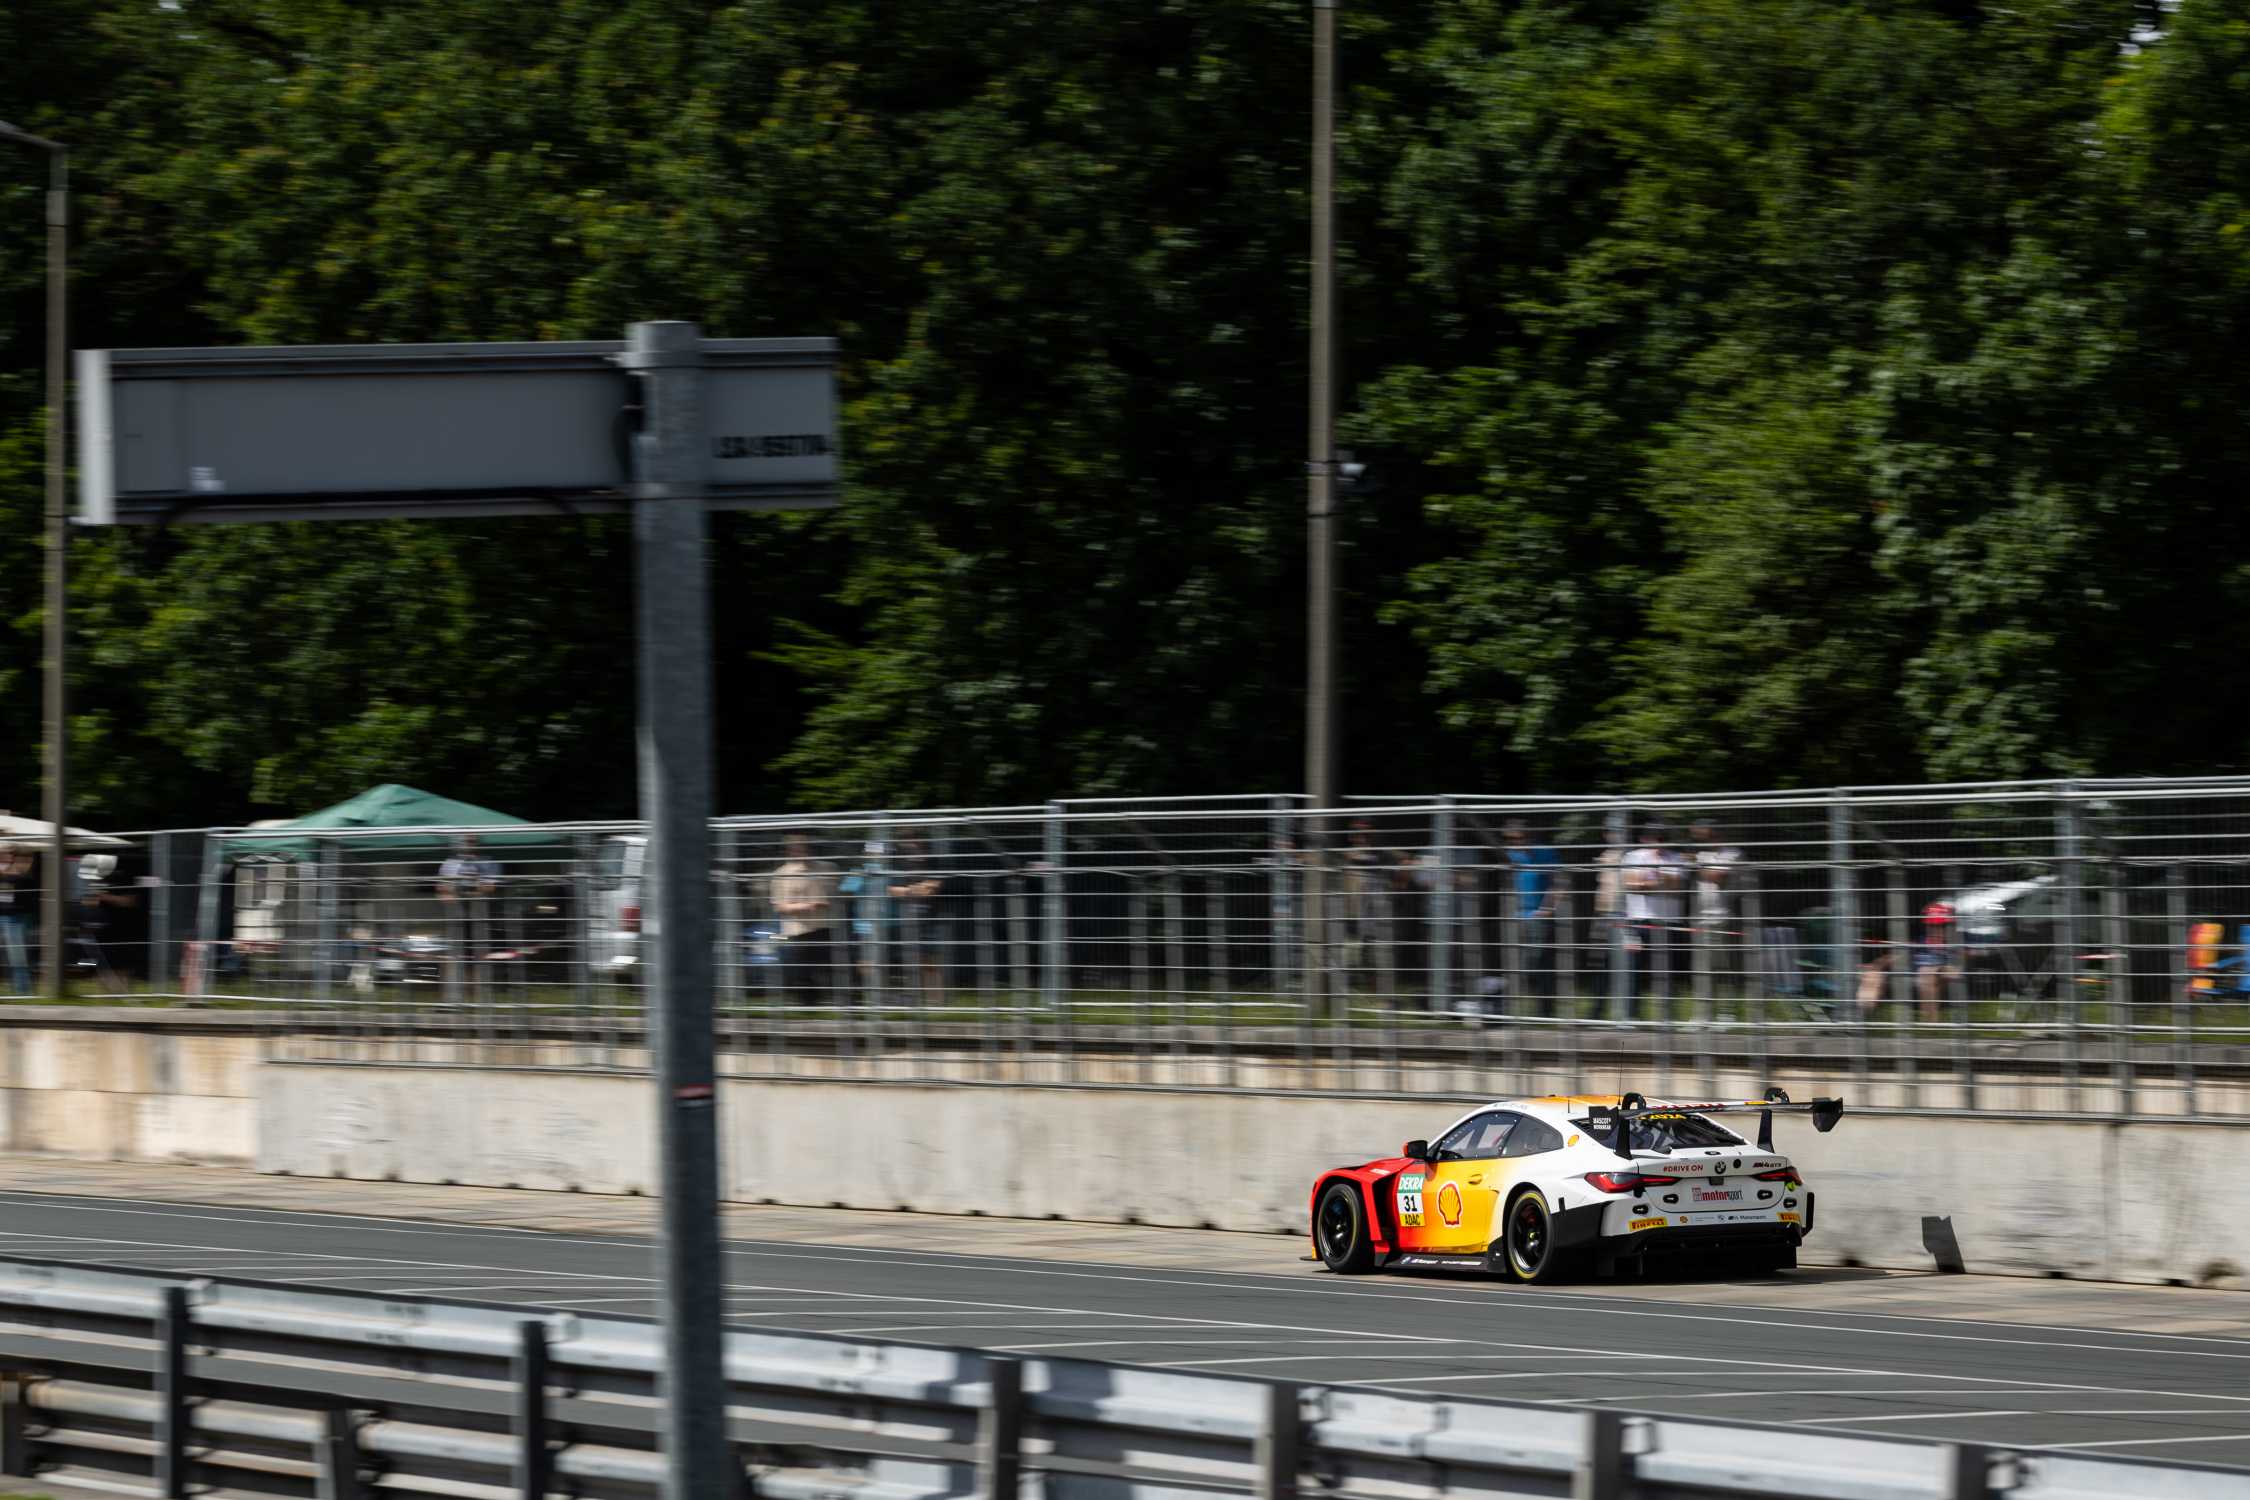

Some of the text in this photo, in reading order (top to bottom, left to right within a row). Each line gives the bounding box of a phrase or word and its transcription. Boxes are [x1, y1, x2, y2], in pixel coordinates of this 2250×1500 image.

[1663, 1163, 1704, 1173] #DRIVE ON
[1398, 1176, 1424, 1191] DEKRA
[1702, 1190, 1743, 1201] motorsport
[1403, 1195, 1418, 1212] 31
[1404, 1214, 1421, 1226] ADAC
[1631, 1218, 1665, 1230] PIRELLI
